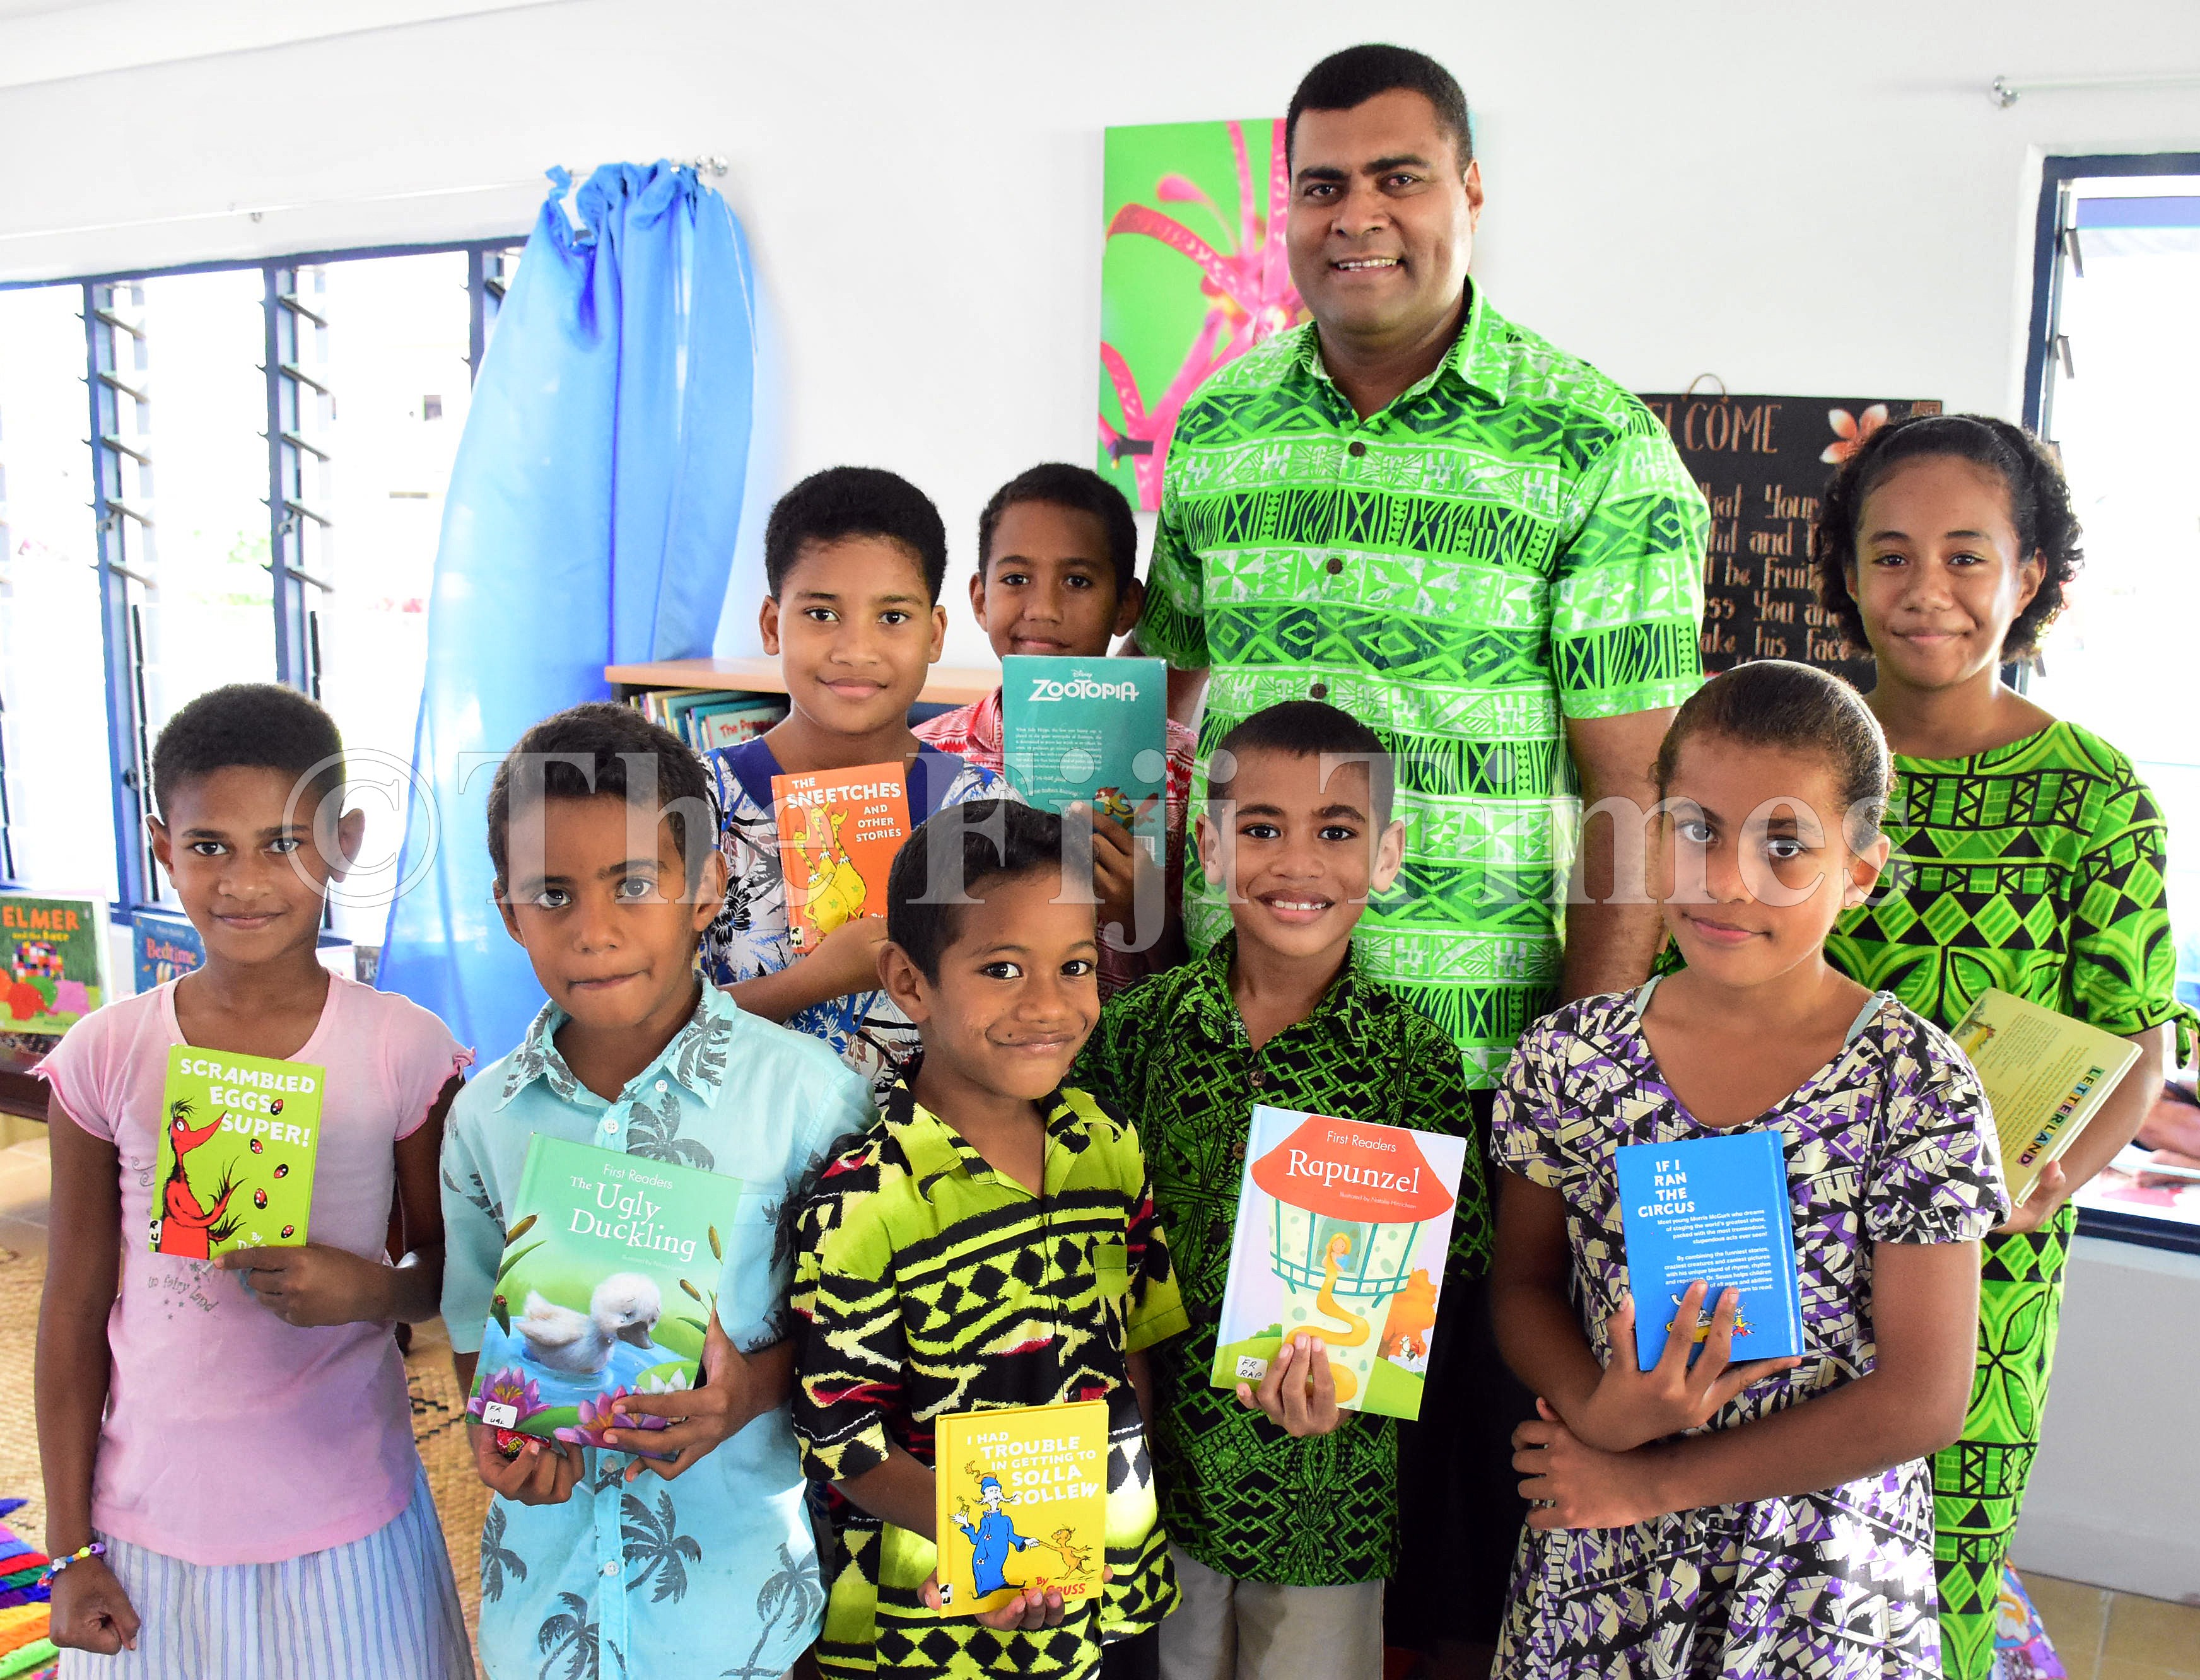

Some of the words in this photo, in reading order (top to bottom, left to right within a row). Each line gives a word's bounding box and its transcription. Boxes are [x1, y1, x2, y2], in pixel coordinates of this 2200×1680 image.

[1749, 521, 1793, 556] and
[1753, 590, 1794, 624] You
[1028, 679, 1139, 701] ZOOTOPIA
[792, 777, 815, 789] THE
[786, 783, 901, 808] SNEETCHES
[863, 805, 887, 815] AND
[858, 818, 894, 827] OTHER
[856, 829, 901, 842] STORIES
[2, 905, 81, 931] ELMER
[146, 938, 197, 965] Bedtime
[180, 1058, 315, 1094] SCRAMBLED
[209, 1086, 271, 1114] EGGS
[2020, 1068, 2102, 1165] LETTERLAND
[221, 1112, 311, 1148] SUPER!
[1327, 1130, 1350, 1146] First
[1352, 1134, 1396, 1153] Readers
[602, 1164, 626, 1180] First
[628, 1169, 673, 1189] Readers
[1285, 1148, 1420, 1194] Rapunzel
[1656, 1160, 1670, 1172] IF
[1675, 1159, 1680, 1170] I
[1654, 1172, 1687, 1186] RAN
[570, 1176, 592, 1191] The
[596, 1182, 662, 1226] Ugly
[1656, 1187, 1687, 1201] THE
[1638, 1201, 1695, 1218] CIRCUS
[252, 1232, 262, 1244] By
[568, 1208, 697, 1262] Duckling
[1685, 1252, 1714, 1261] combining
[1243, 1359, 1256, 1368] FR
[967, 1436, 971, 1445] I
[978, 1432, 1009, 1444] HAD
[980, 1437, 1080, 1459] TROUBLE
[992, 1461, 1007, 1470] IN
[1012, 1452, 1074, 1468] GETTING
[1077, 1450, 1096, 1461] TO
[1012, 1466, 1082, 1486] SOLLA
[1012, 1482, 1099, 1506] SOLLEW
[1036, 1577, 1048, 1585] By
